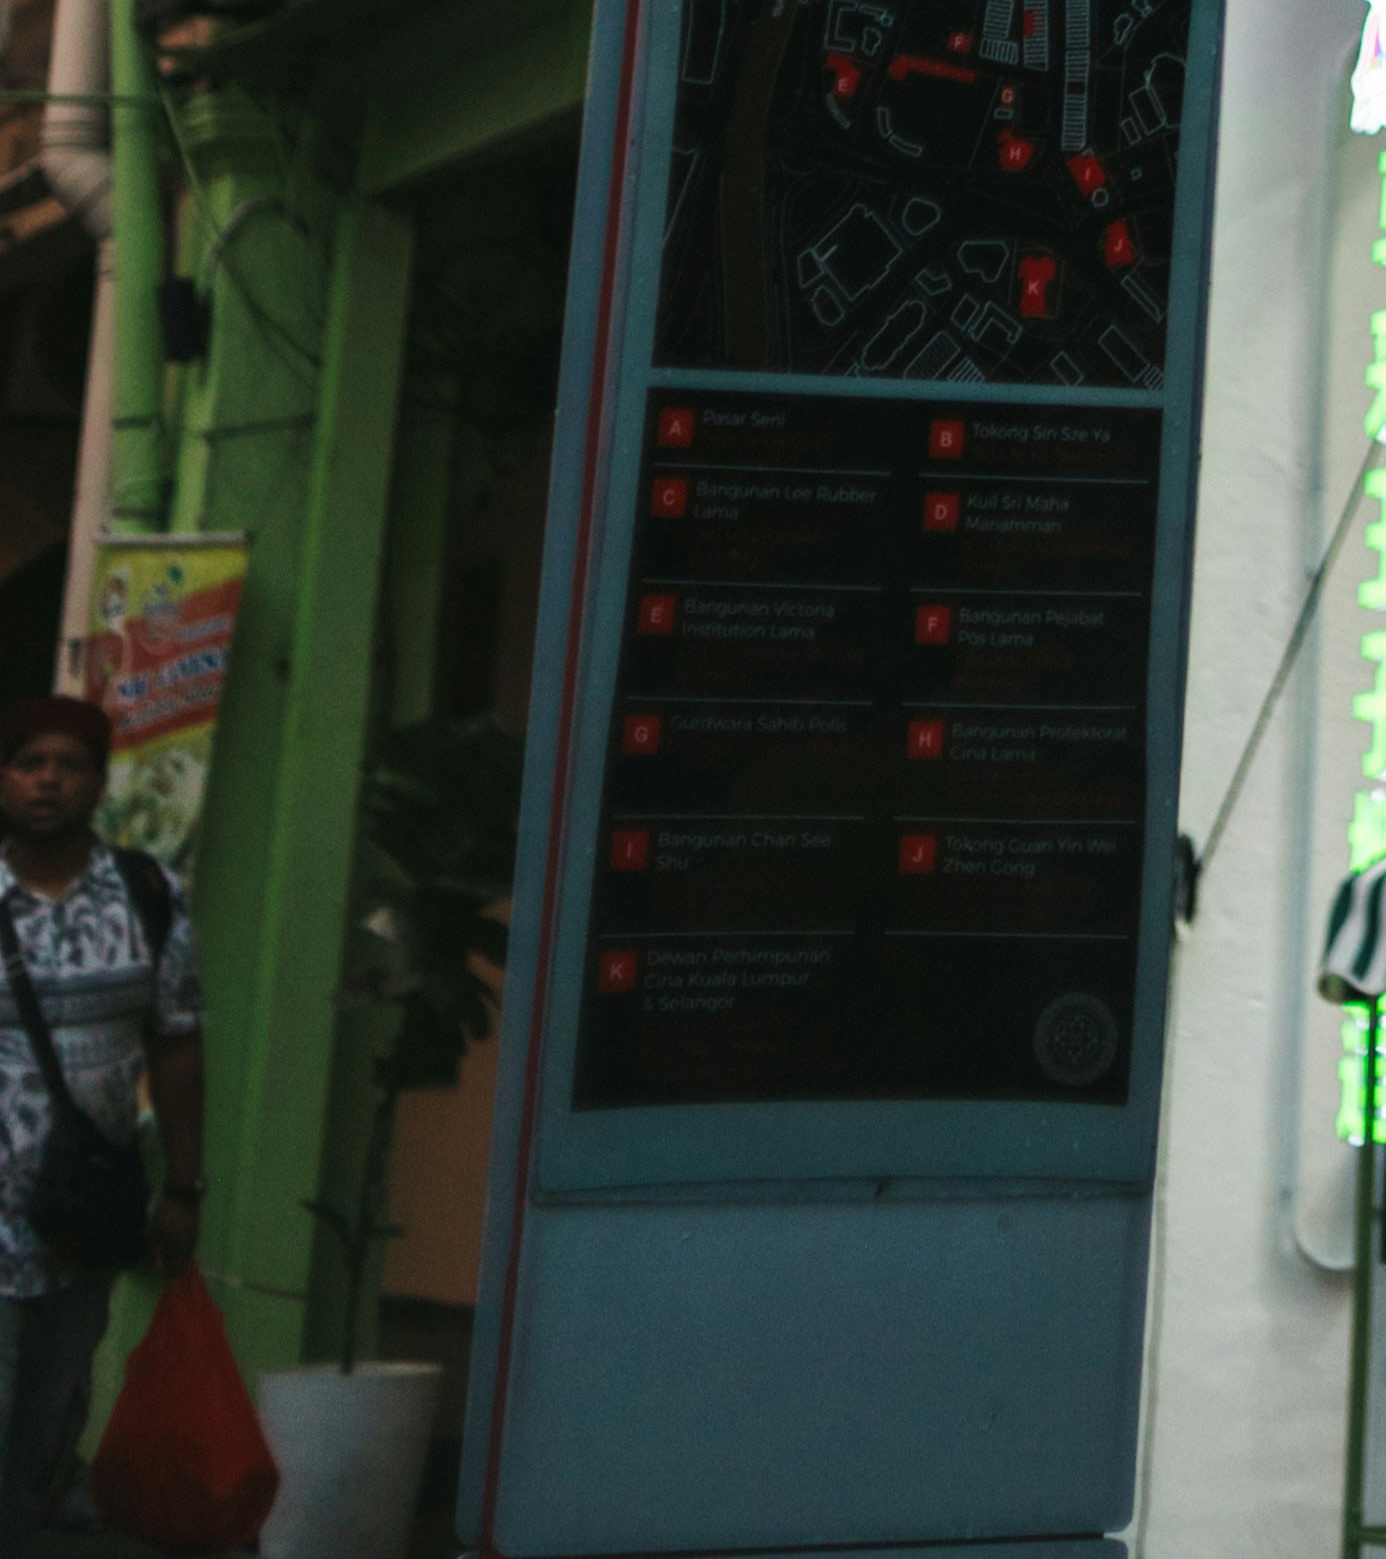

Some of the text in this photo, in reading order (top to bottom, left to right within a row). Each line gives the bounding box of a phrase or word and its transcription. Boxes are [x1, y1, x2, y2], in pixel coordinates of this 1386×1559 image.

[669, 419, 682, 436] A
[940, 431, 952, 448] B
[661, 488, 675, 506] C
[934, 504, 948, 521] D
[650, 606, 663, 624] E
[918, 731, 932, 749] H
[610, 962, 624, 980] K
